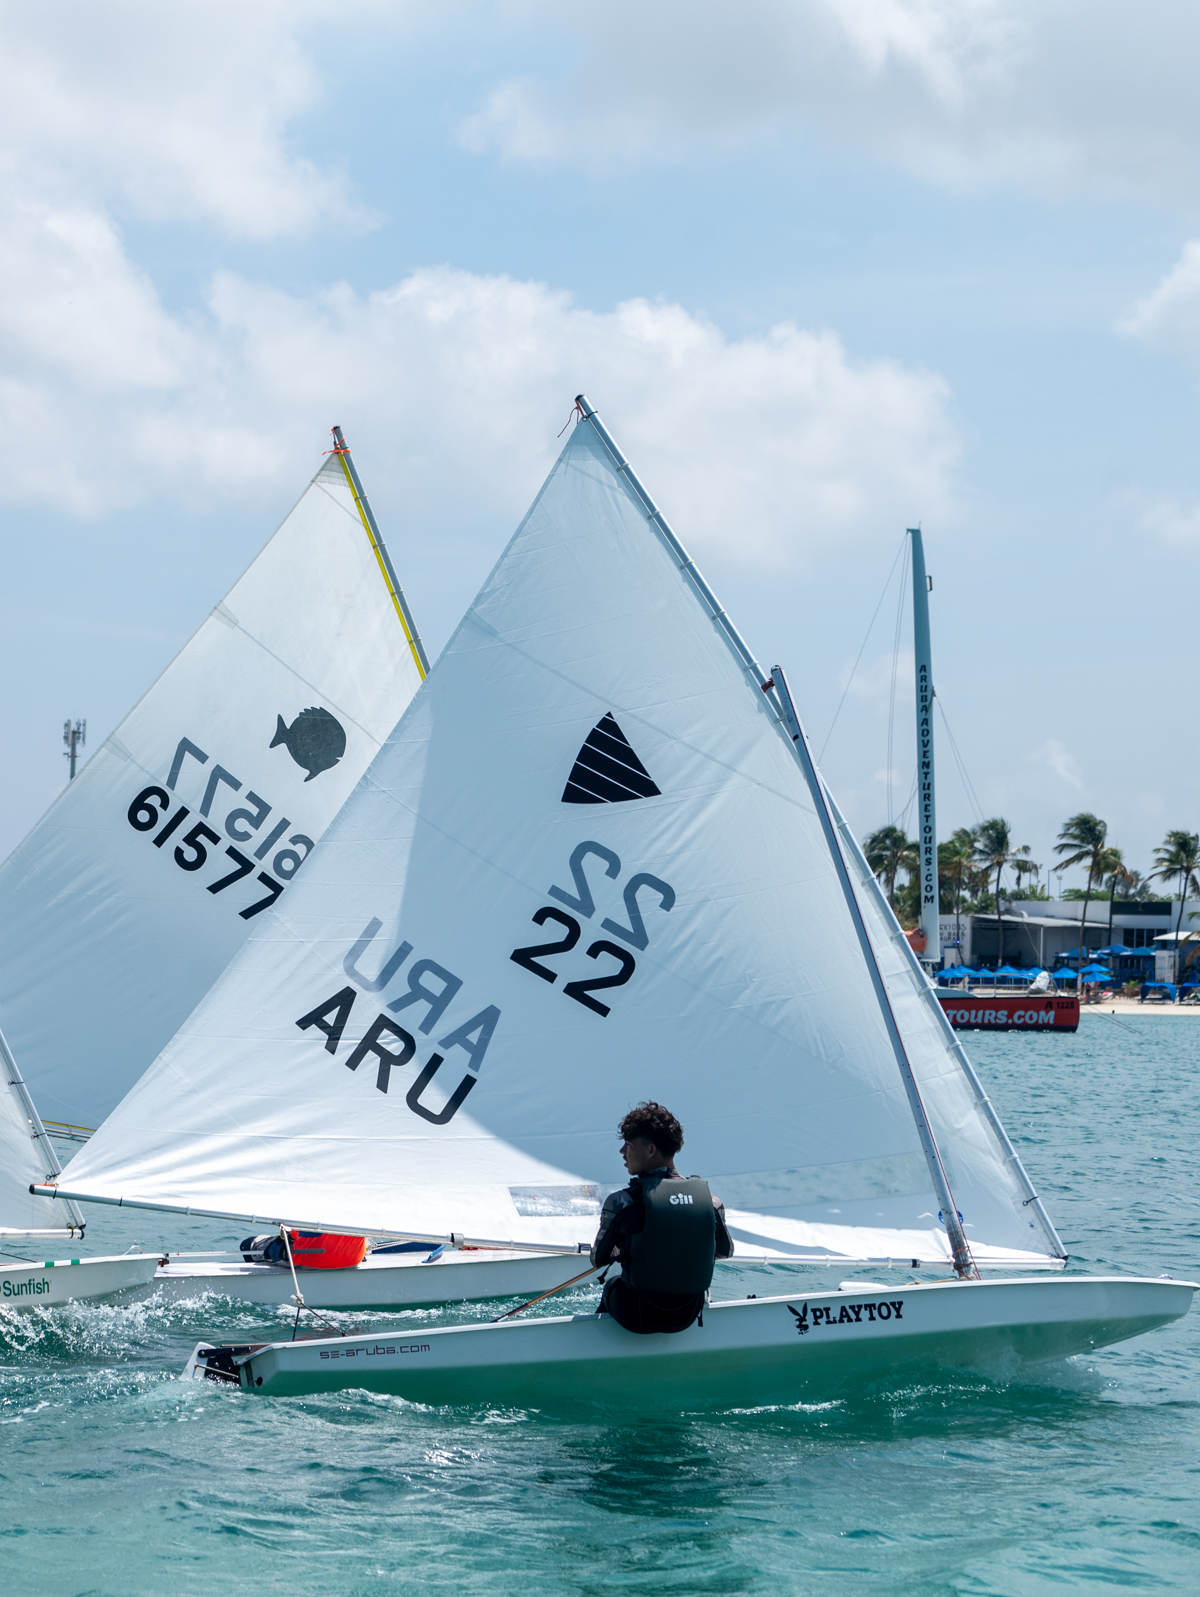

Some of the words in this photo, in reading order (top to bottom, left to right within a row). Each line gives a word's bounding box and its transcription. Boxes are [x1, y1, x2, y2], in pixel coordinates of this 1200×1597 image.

[127, 785, 285, 920] 61577
[509, 906, 636, 1018] 22
[1044, 1001, 1053, 1009] A
[1056, 1001, 1074, 1009] 1228
[295, 985, 477, 1125] ARU
[669, 1193, 694, 1205] Gill
[2, 1278, 50, 1297] Sunfish
[810, 1300, 904, 1326] PLAYTOY
